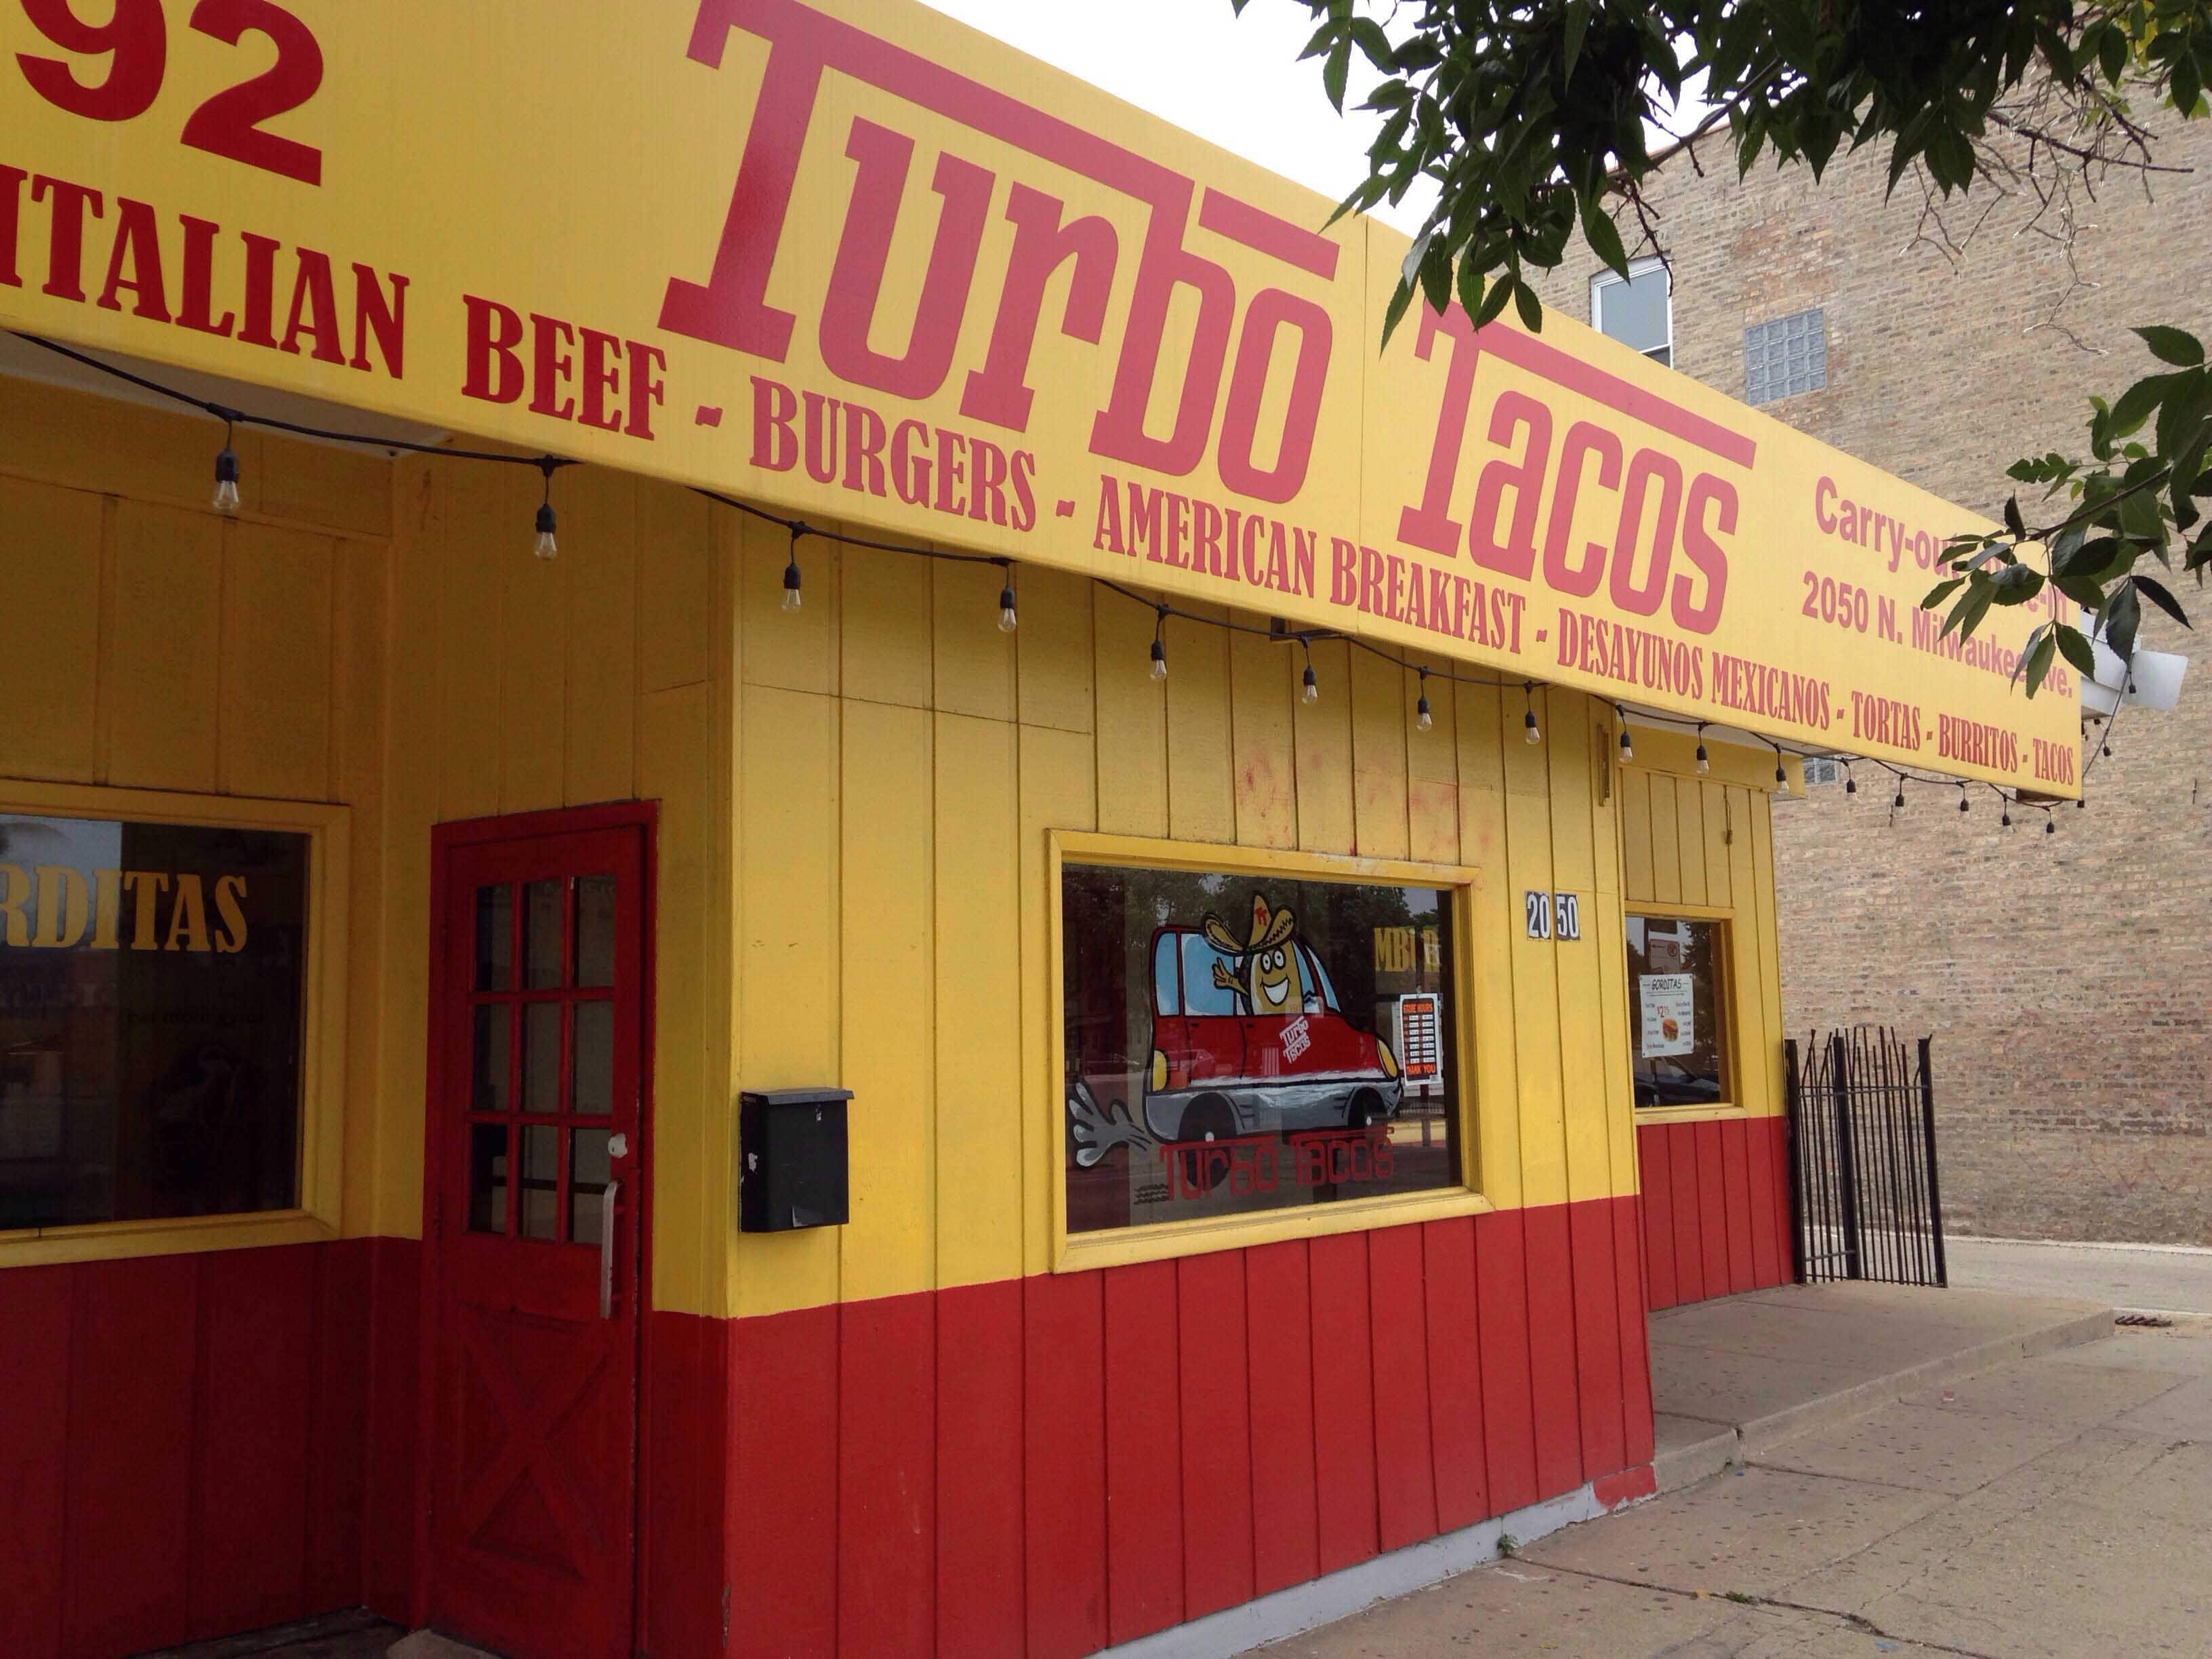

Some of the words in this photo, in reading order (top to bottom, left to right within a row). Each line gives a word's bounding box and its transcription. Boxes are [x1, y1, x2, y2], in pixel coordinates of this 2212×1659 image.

[0, 163, 409, 380] ITALIAN
[462, 294, 665, 441] BEEF
[750, 375, 1036, 532] BURGERS
[1093, 474, 1317, 598] AMERICAN
[1330, 537, 1525, 654] BREAKFAST
[1557, 608, 1703, 700] DESAYUNOS
[1711, 651, 1830, 731] MEXICANOS
[1851, 691, 1921, 751] TORTAS
[1938, 713, 2018, 773] BURRITOS
[2033, 737, 2074, 785] TACOS
[657, 0, 1340, 504] Turbo
[1397, 297, 1757, 634] Tacos
[1802, 571, 1868, 633] 2050
[1878, 595, 1903, 644] N.
[2041, 664, 2073, 698] ve.
[1527, 894, 1580, 939] 2050
